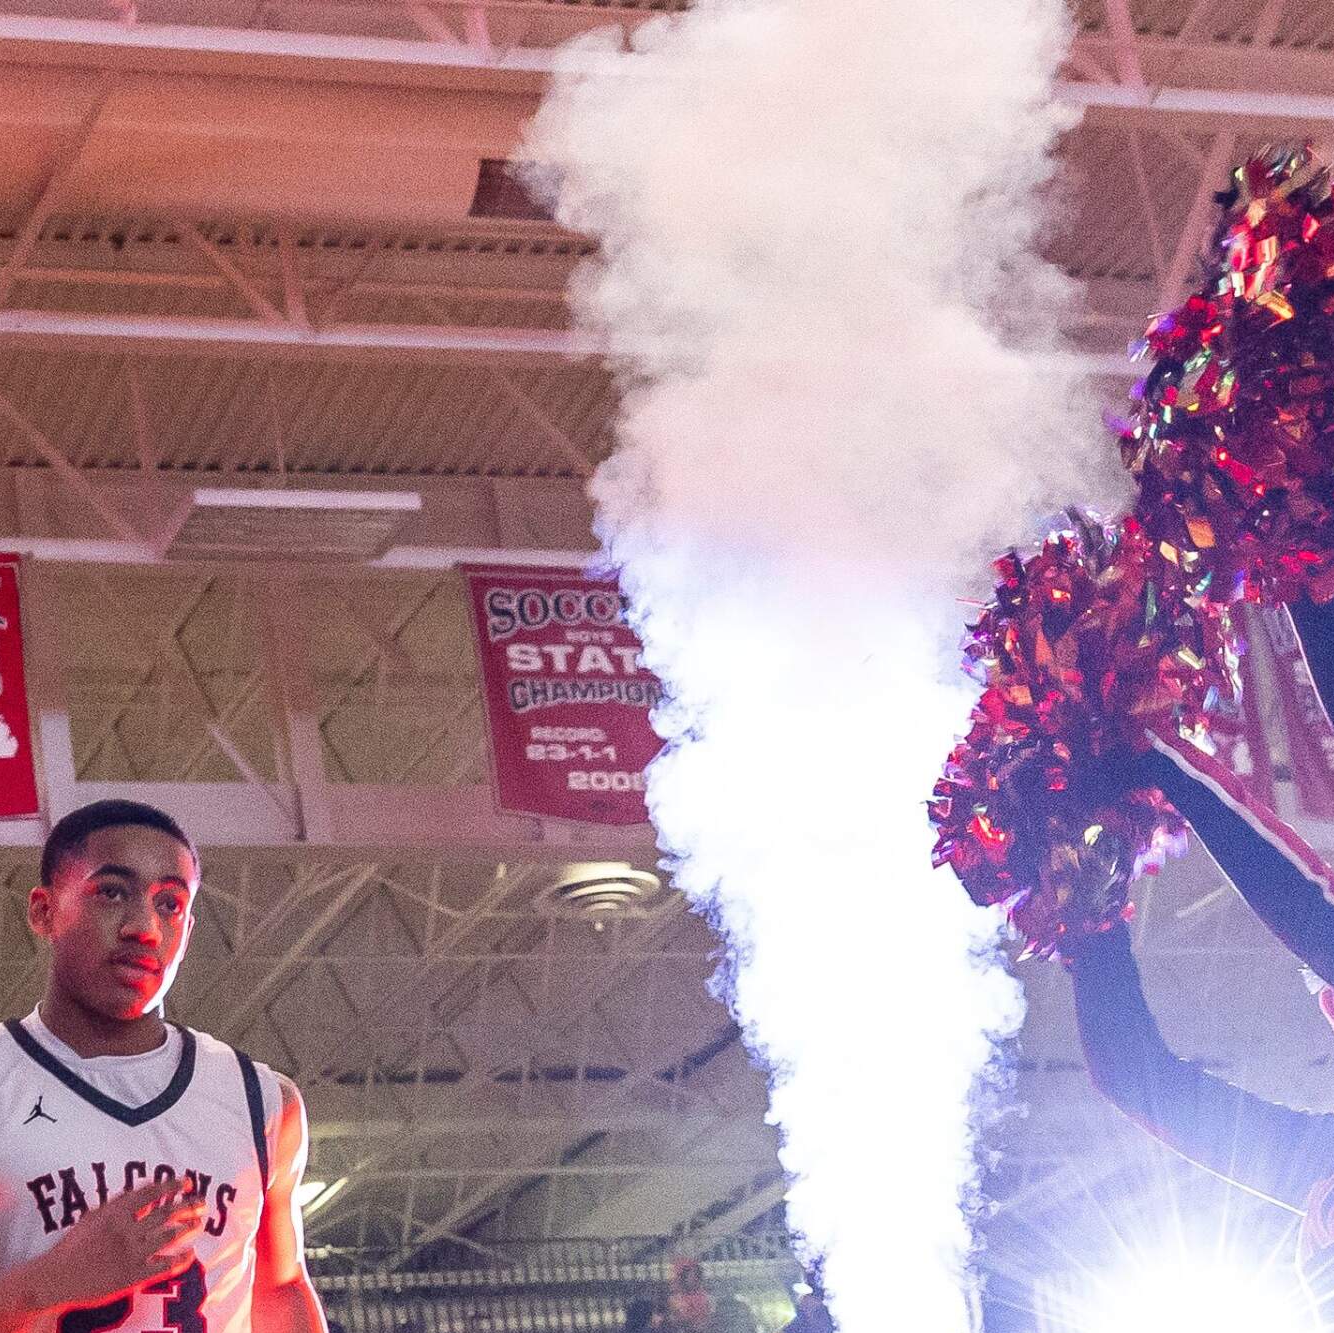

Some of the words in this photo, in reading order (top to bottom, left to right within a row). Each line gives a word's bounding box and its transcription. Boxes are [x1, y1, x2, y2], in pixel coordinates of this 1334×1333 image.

[484, 588, 631, 642] SOCC
[505, 643, 644, 674] STAT
[507, 677, 666, 715] CHAMPION
